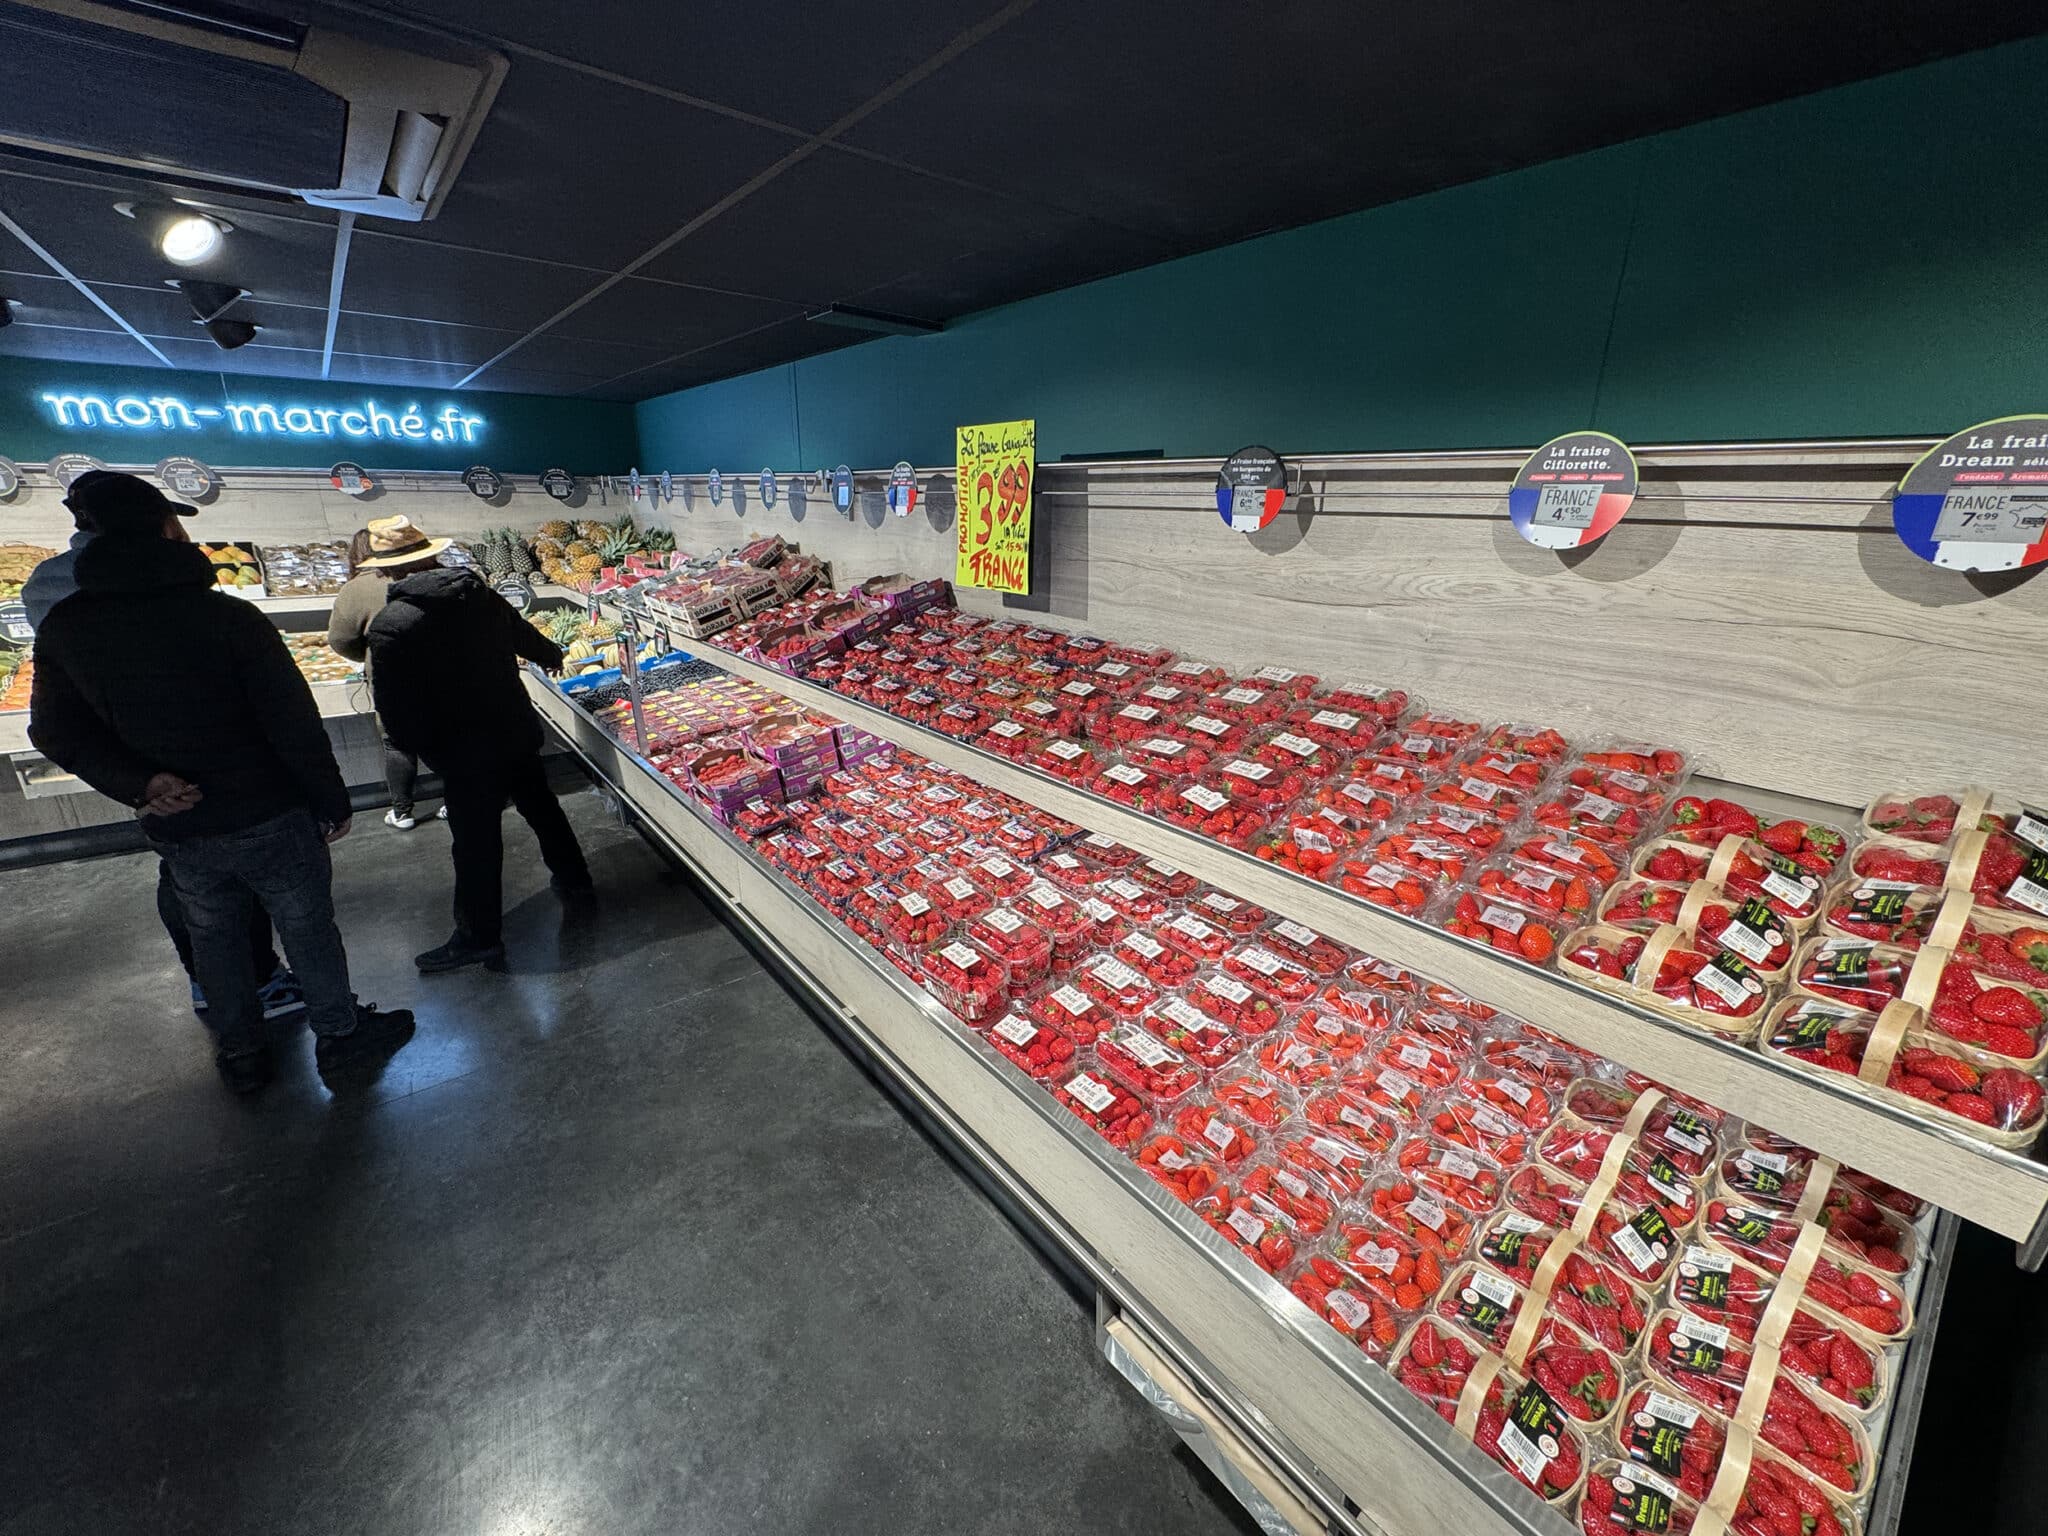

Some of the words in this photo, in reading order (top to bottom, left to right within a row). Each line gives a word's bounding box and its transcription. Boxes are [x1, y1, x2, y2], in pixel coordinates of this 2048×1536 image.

[42, 392, 483, 442] mon-marché.fr
[1550, 447, 1565, 457] La
[1570, 446, 1610, 457] fraise
[1966, 436, 1994, 449] La
[2001, 434, 2048, 449] frai
[1542, 459, 1611, 471] Ciflorette.
[1939, 454, 2014, 467] Dream
[1545, 489, 1595, 506] FRANCE
[1944, 495, 2008, 510] FRANCE
[959, 465, 969, 554] PROMOTION
[969, 548, 1025, 591] FRANCE
[1528, 1402, 1547, 1428] Dream
[1651, 1427, 1667, 1454] Dream
[1635, 1494, 1649, 1523] Dream
